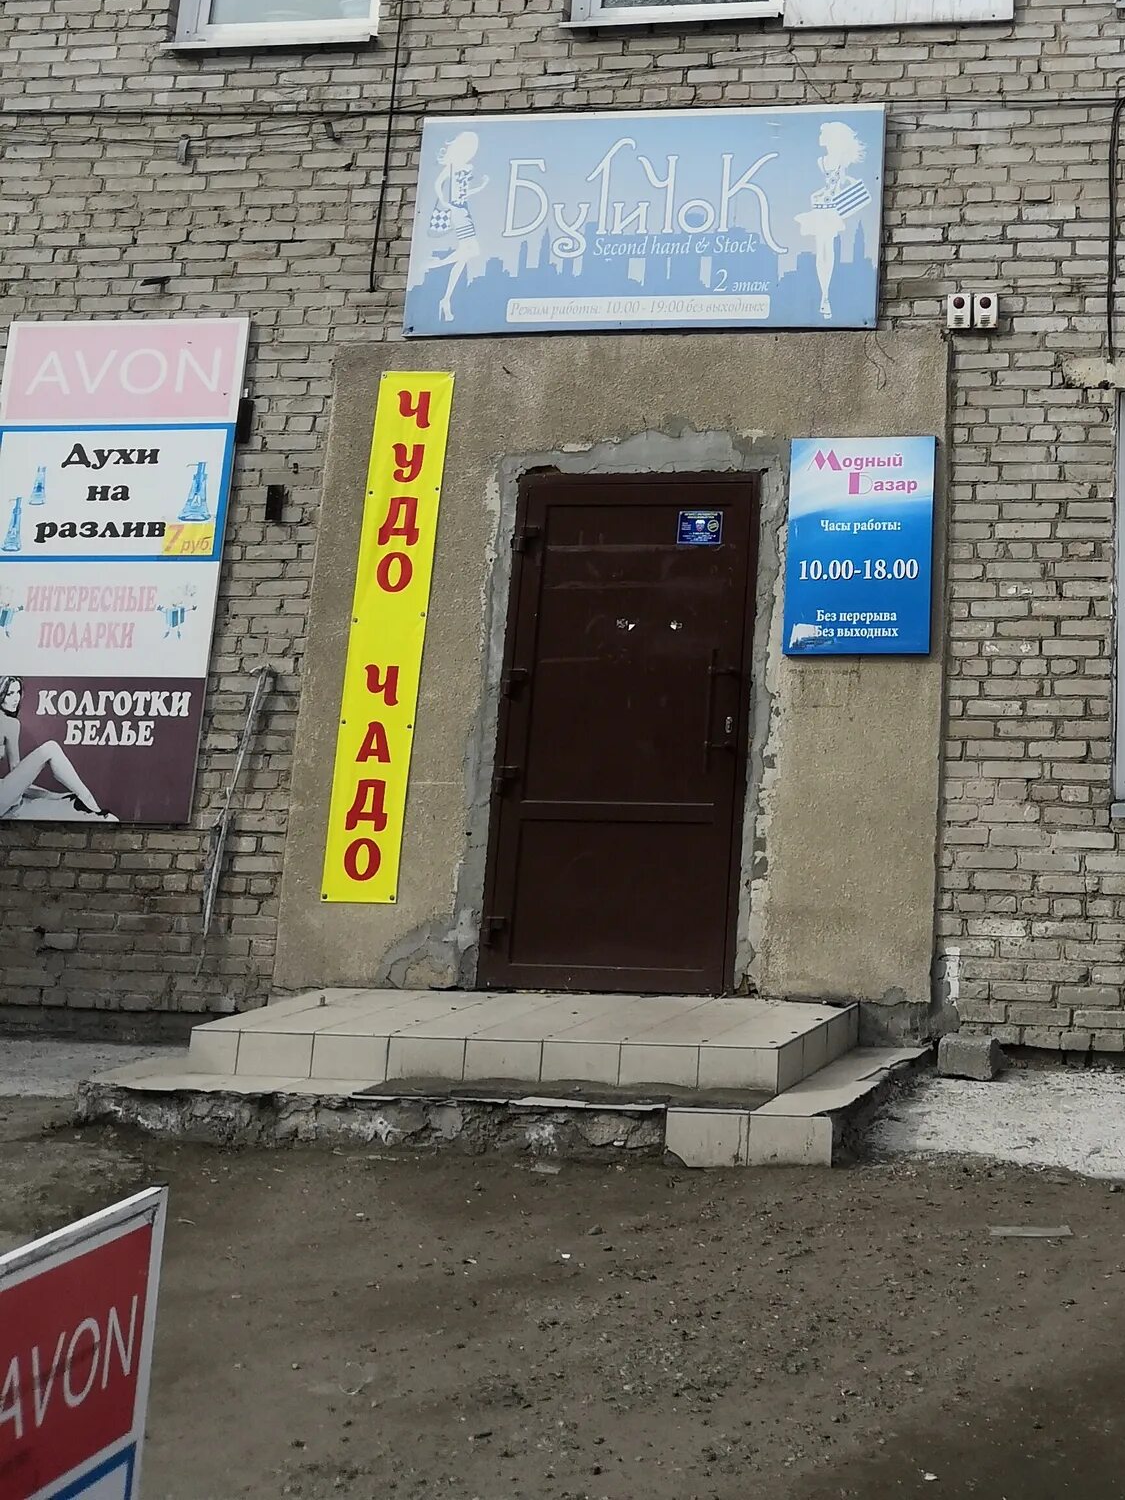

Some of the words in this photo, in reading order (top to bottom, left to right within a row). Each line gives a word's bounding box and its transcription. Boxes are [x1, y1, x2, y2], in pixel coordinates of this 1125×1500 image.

[593, 237, 648, 256] Second
[650, 235, 690, 255] hand
[694, 237, 709, 253] &
[713, 234, 757, 254] Stock
[713, 268, 729, 293] 2
[731, 279, 770, 293] этаж
[24, 347, 222, 396] AVON
[61, 443, 160, 470] Духи
[807, 449, 904, 471] Модный
[86, 484, 130, 501] на
[375, 389, 432, 594] ЧУДО
[848, 471, 918, 495] Базар
[34, 521, 168, 543] разлив
[164, 524, 185, 552] 7
[180, 535, 211, 554] руб.
[820, 519, 850, 531] Часы
[852, 519, 901, 534] работы:
[798, 558, 920, 581] 10.00-18.00
[25, 585, 158, 613] ИНТЕРЕСНЫЕ
[815, 609, 837, 622] Без
[839, 611, 898, 625] перерыва
[38, 621, 135, 652] ПОДАРКИ
[814, 625, 835, 637] Без
[836, 627, 899, 639] выходных
[36, 689, 192, 718] КОЛГОТКИ
[63, 719, 155, 746] БЕЛЬЕ
[343, 663, 399, 883] ЧАДО
[0, 1294, 139, 1440] AVON
